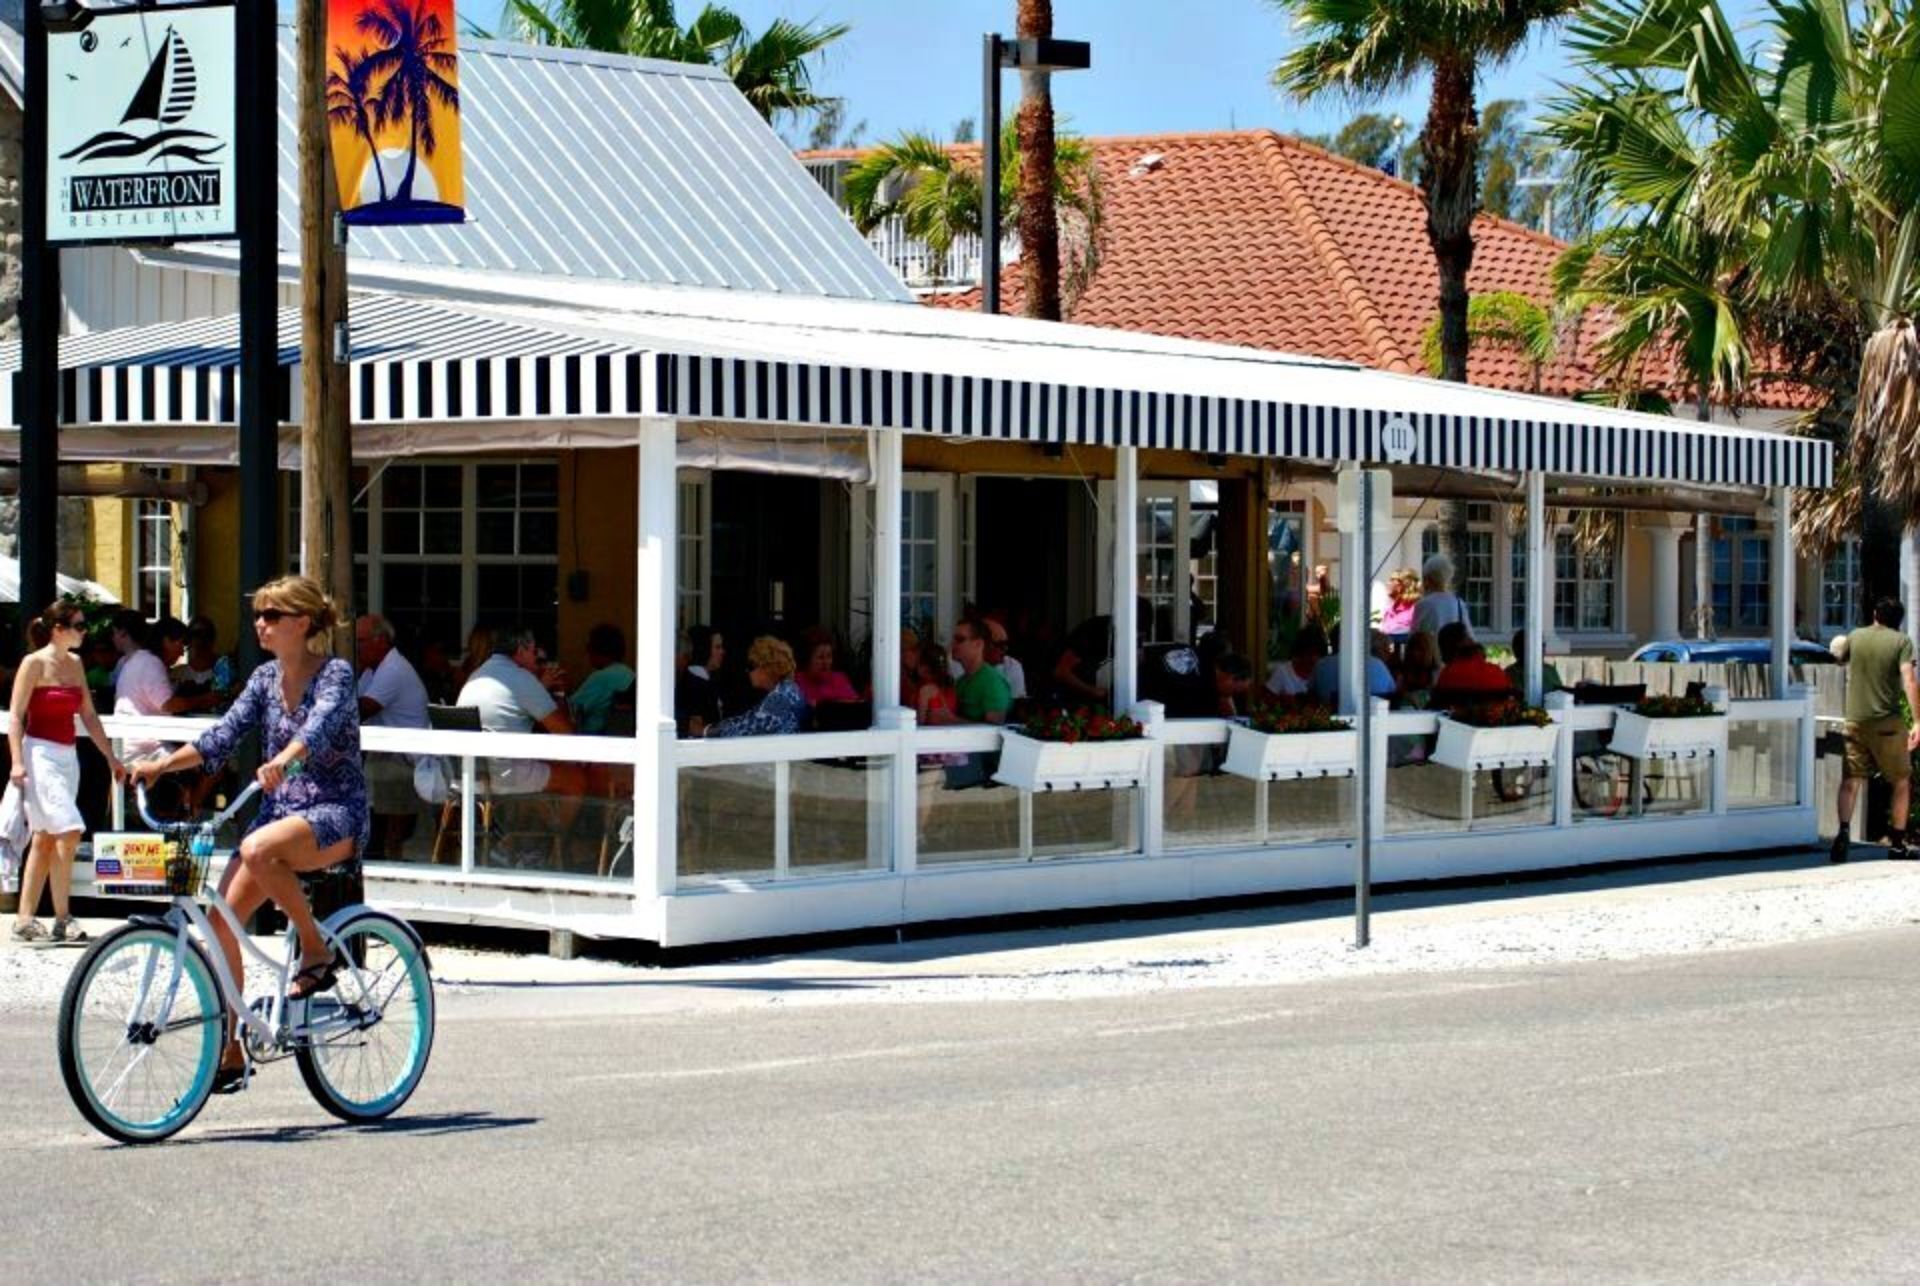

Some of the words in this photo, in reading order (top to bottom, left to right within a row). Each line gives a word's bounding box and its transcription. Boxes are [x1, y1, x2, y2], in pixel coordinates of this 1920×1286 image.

[73, 174, 218, 208] WATERFRONT
[69, 210, 221, 227] RESTAURANT
[123, 842, 145, 856] RENT
[146, 842, 161, 856] ME
